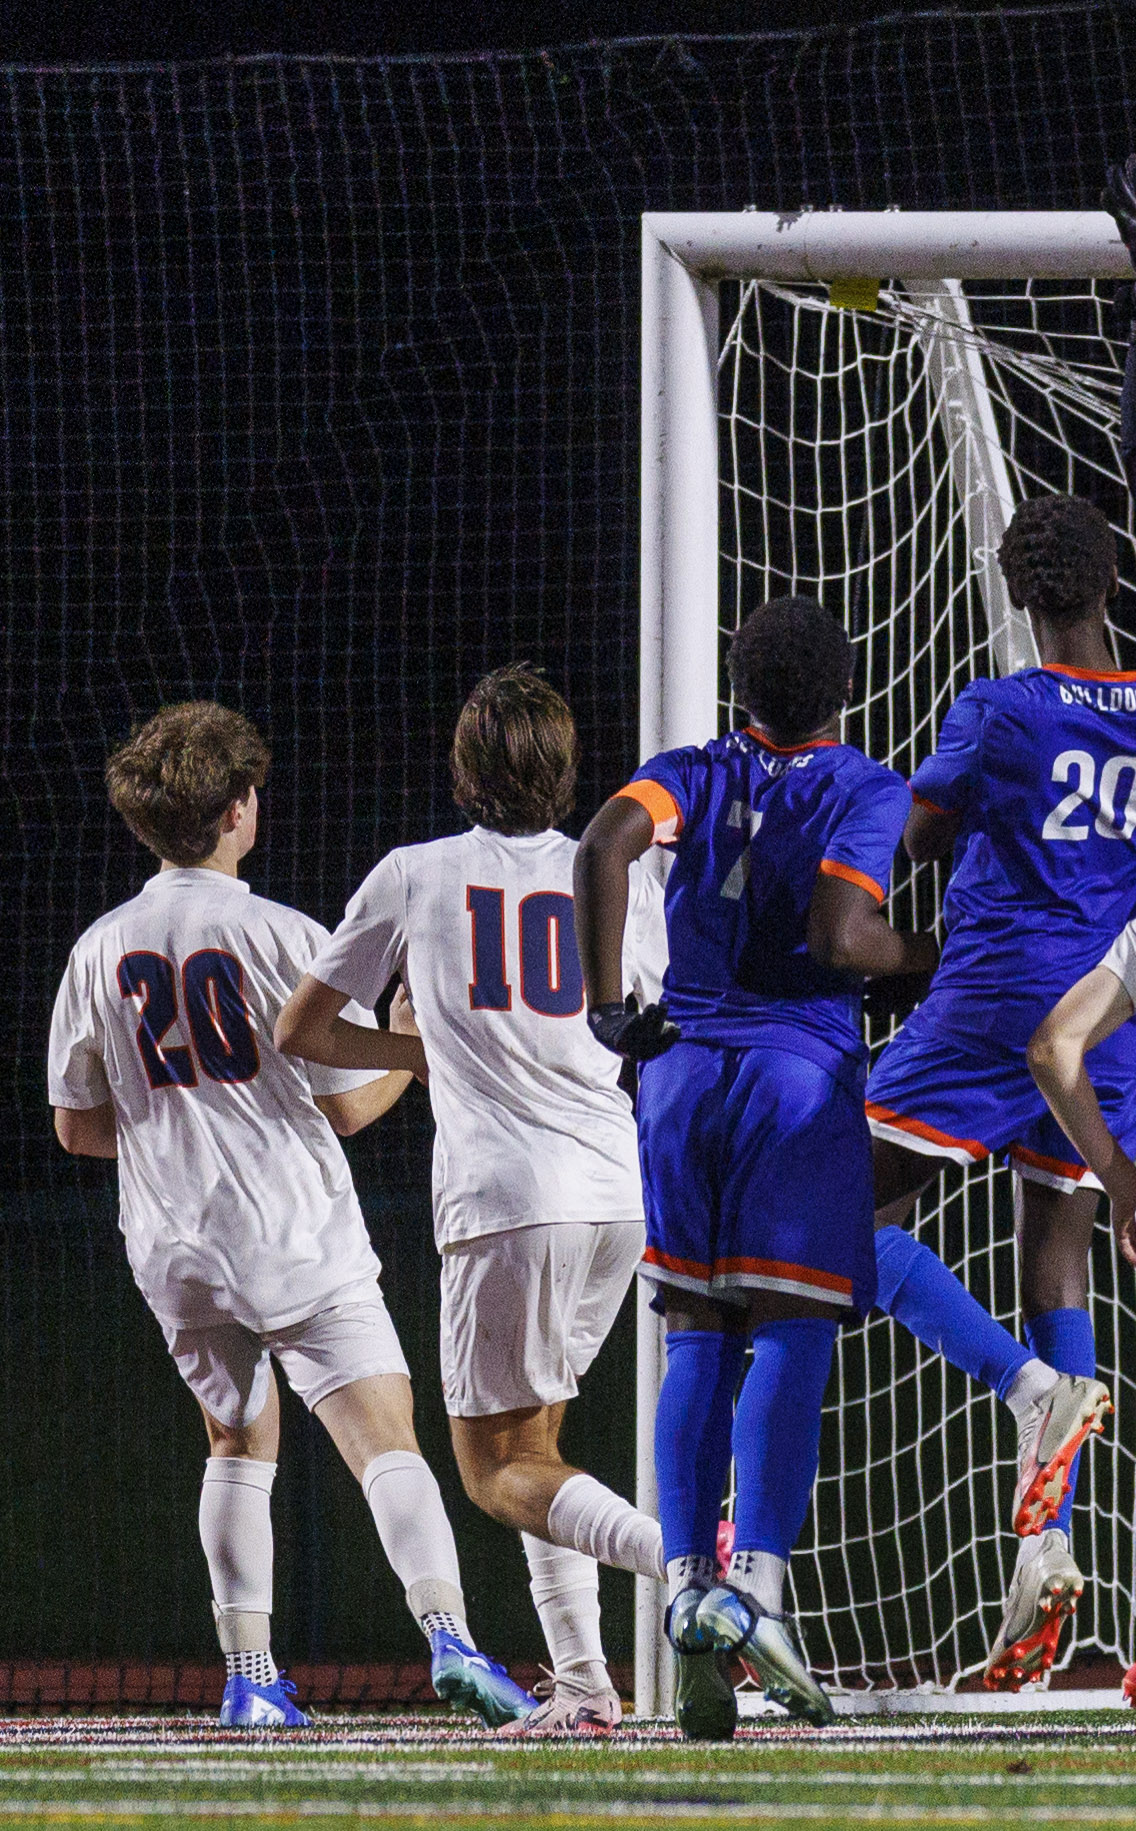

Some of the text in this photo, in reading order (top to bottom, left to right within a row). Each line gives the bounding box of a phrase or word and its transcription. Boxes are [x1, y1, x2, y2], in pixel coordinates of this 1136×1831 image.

[720, 801, 763, 900] 7
[466, 884, 585, 1018] 10
[117, 948, 260, 1090] 20
